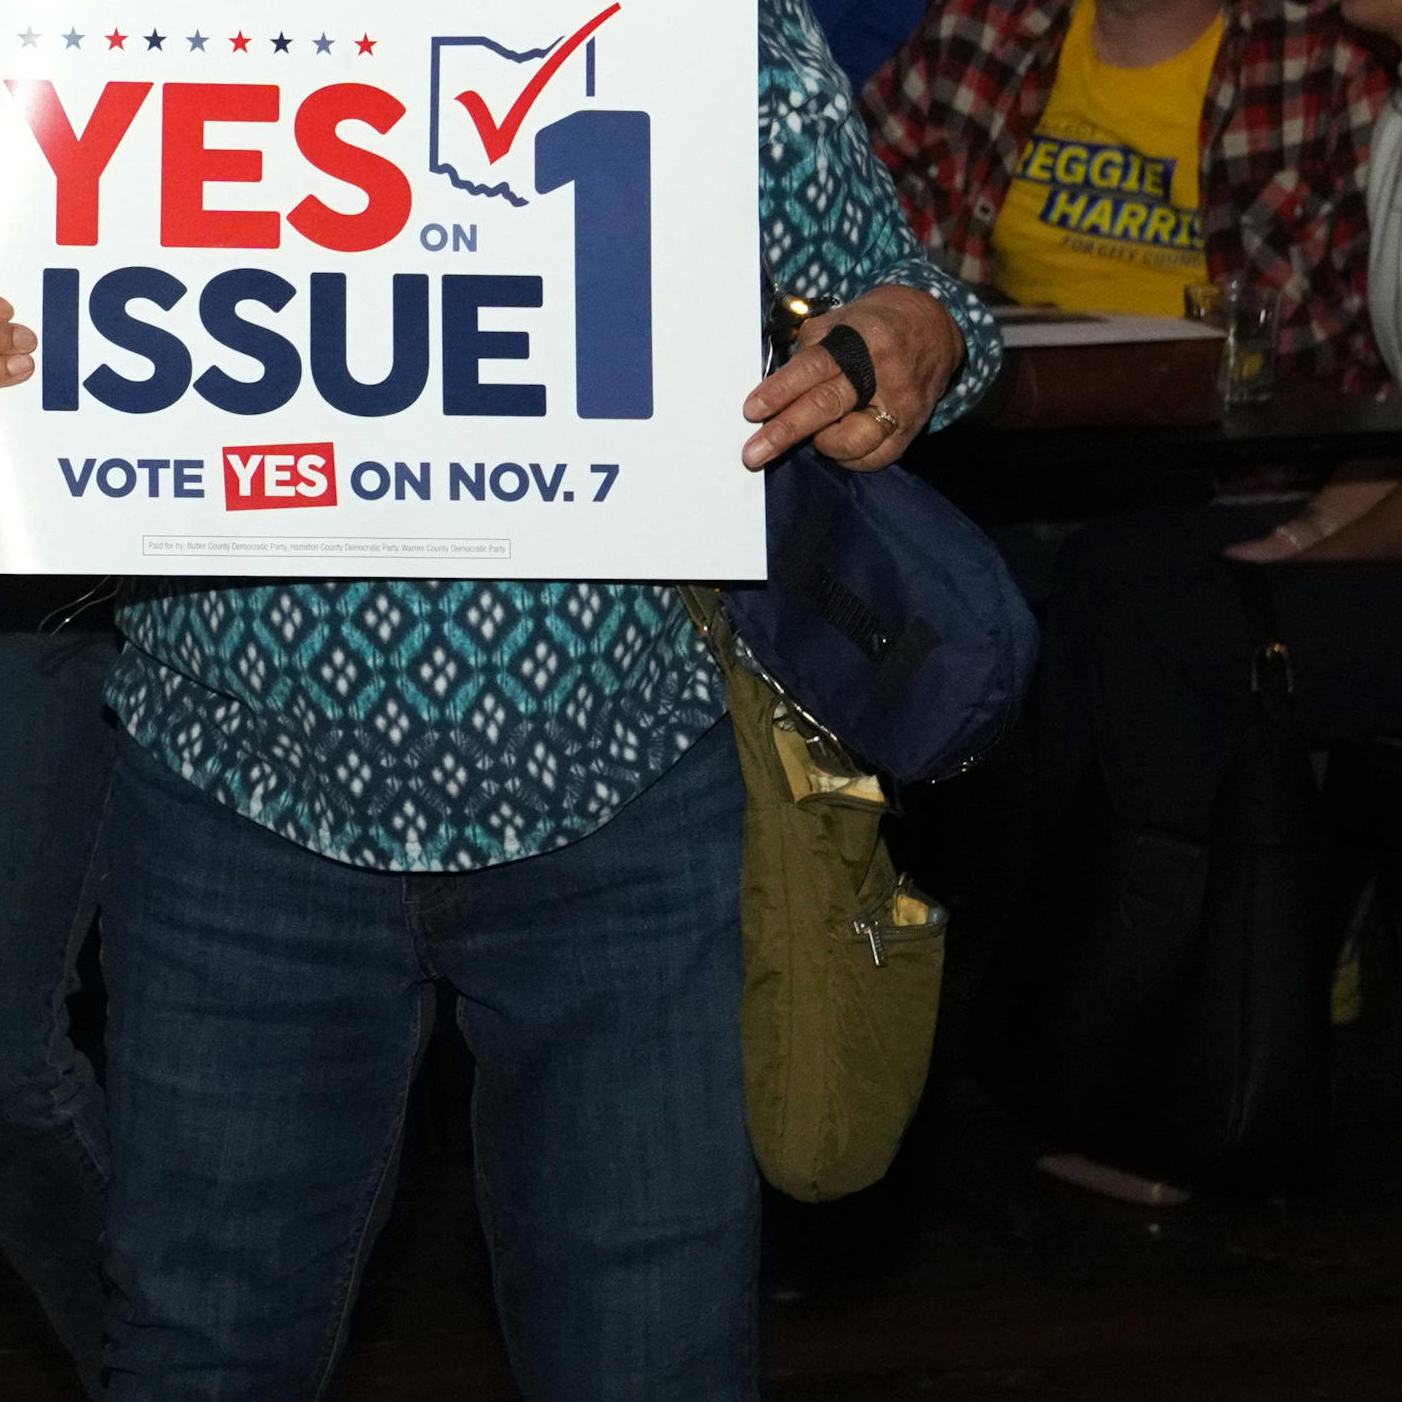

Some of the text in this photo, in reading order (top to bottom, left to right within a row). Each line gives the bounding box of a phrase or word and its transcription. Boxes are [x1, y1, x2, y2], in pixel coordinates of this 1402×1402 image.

[4, 79, 477, 253] YES ON
[42, 110, 653, 419] ISSUE 1
[58, 454, 620, 502] VOTE YES ON NOV. 7
